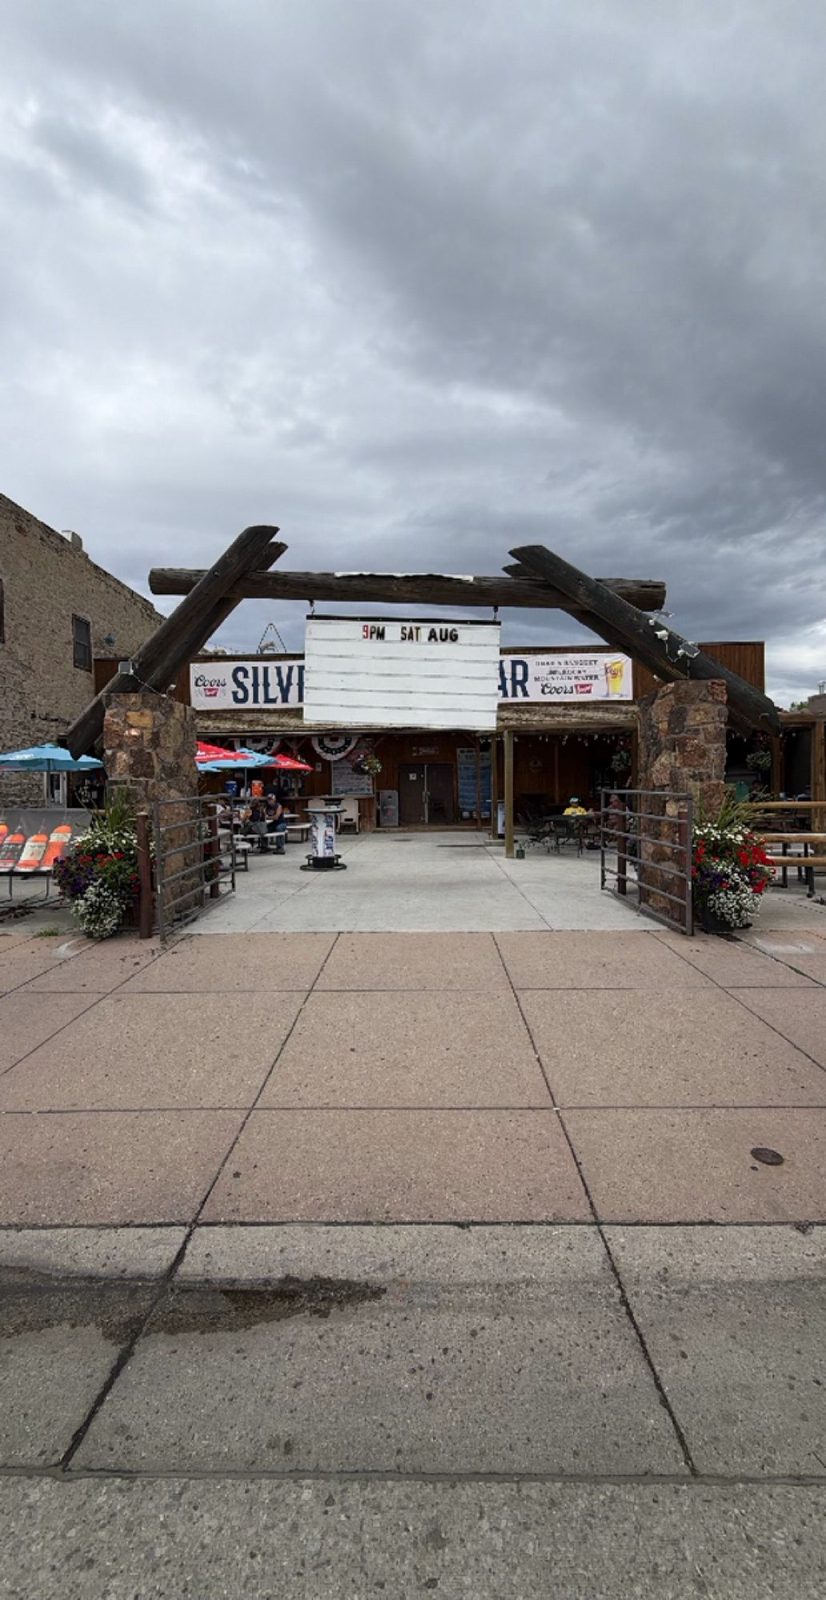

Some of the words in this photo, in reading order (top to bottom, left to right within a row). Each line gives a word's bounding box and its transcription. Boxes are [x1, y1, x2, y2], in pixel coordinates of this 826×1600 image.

[362, 625, 385, 640] 9PM
[401, 626, 420, 642] SAT
[428, 628, 458, 642] AUG
[194, 674, 227, 687] Coors
[541, 682, 574, 695] Coors
